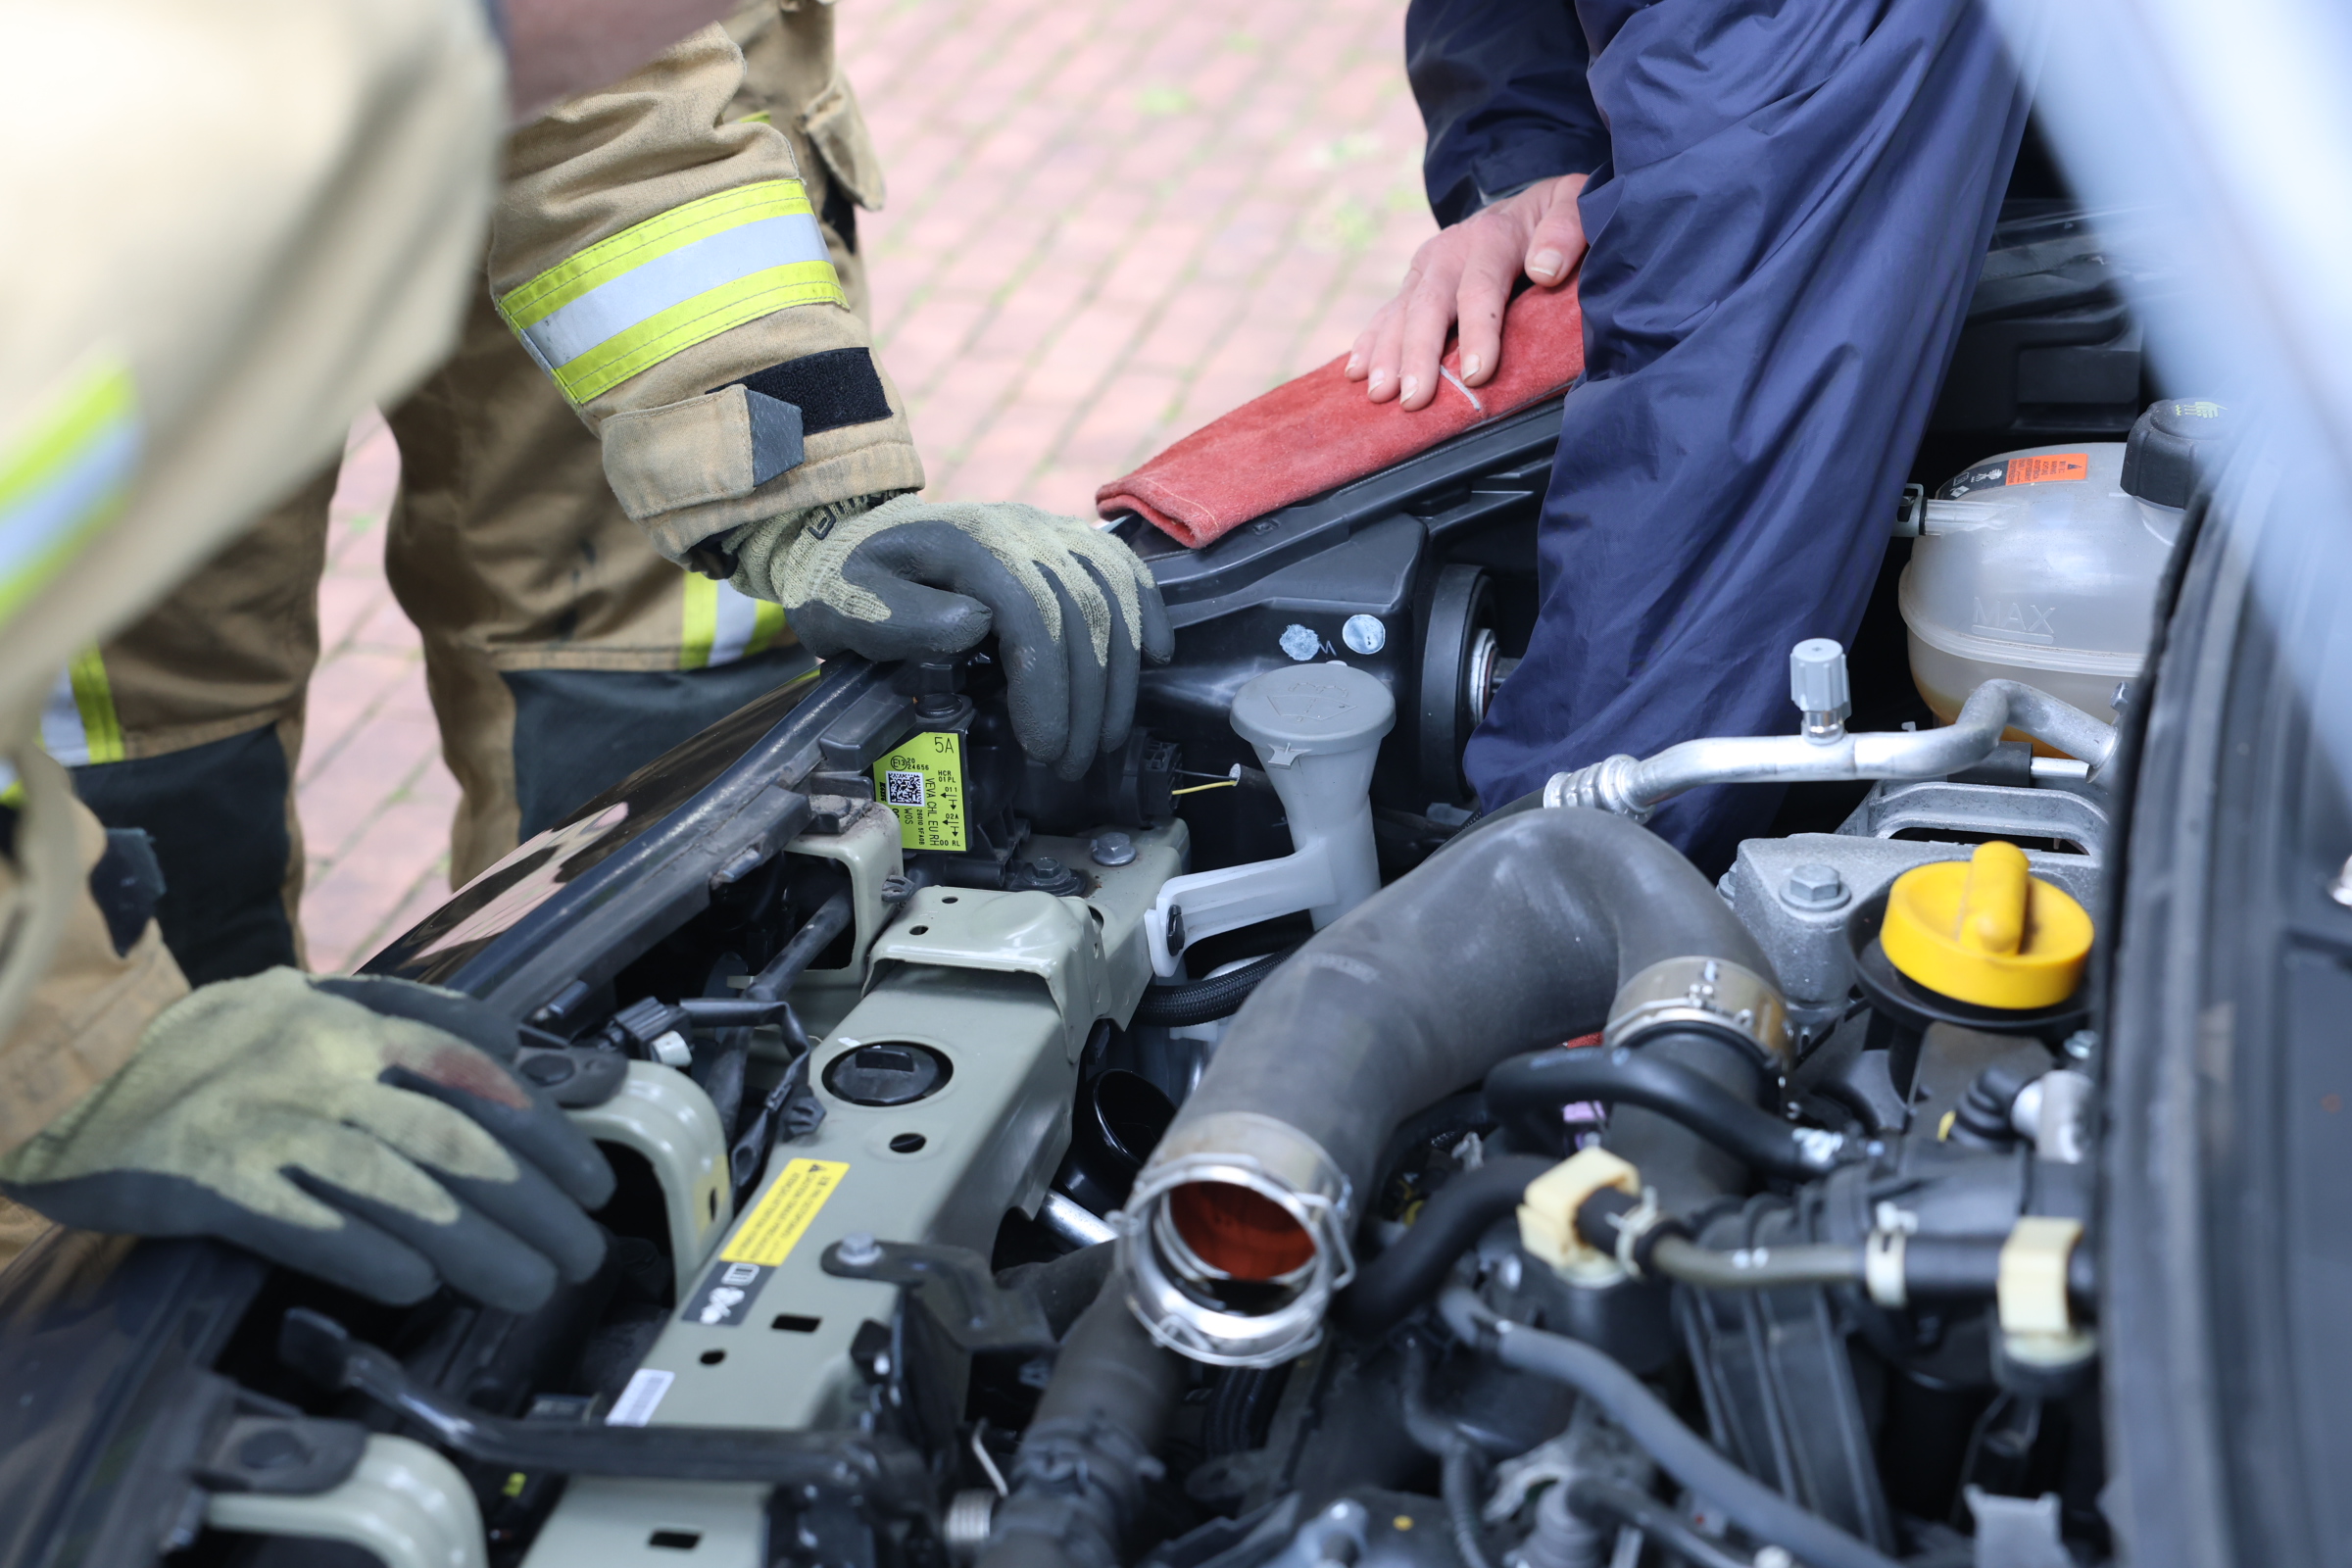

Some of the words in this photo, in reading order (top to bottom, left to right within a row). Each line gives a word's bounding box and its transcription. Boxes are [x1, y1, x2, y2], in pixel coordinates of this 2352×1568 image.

[1973, 596, 2055, 634] MAX
[934, 736, 955, 754] 5A
[925, 777, 936, 798] VEVA
[926, 801, 937, 817] CHL
[927, 820, 939, 832] EU
[929, 834, 940, 846] RH
